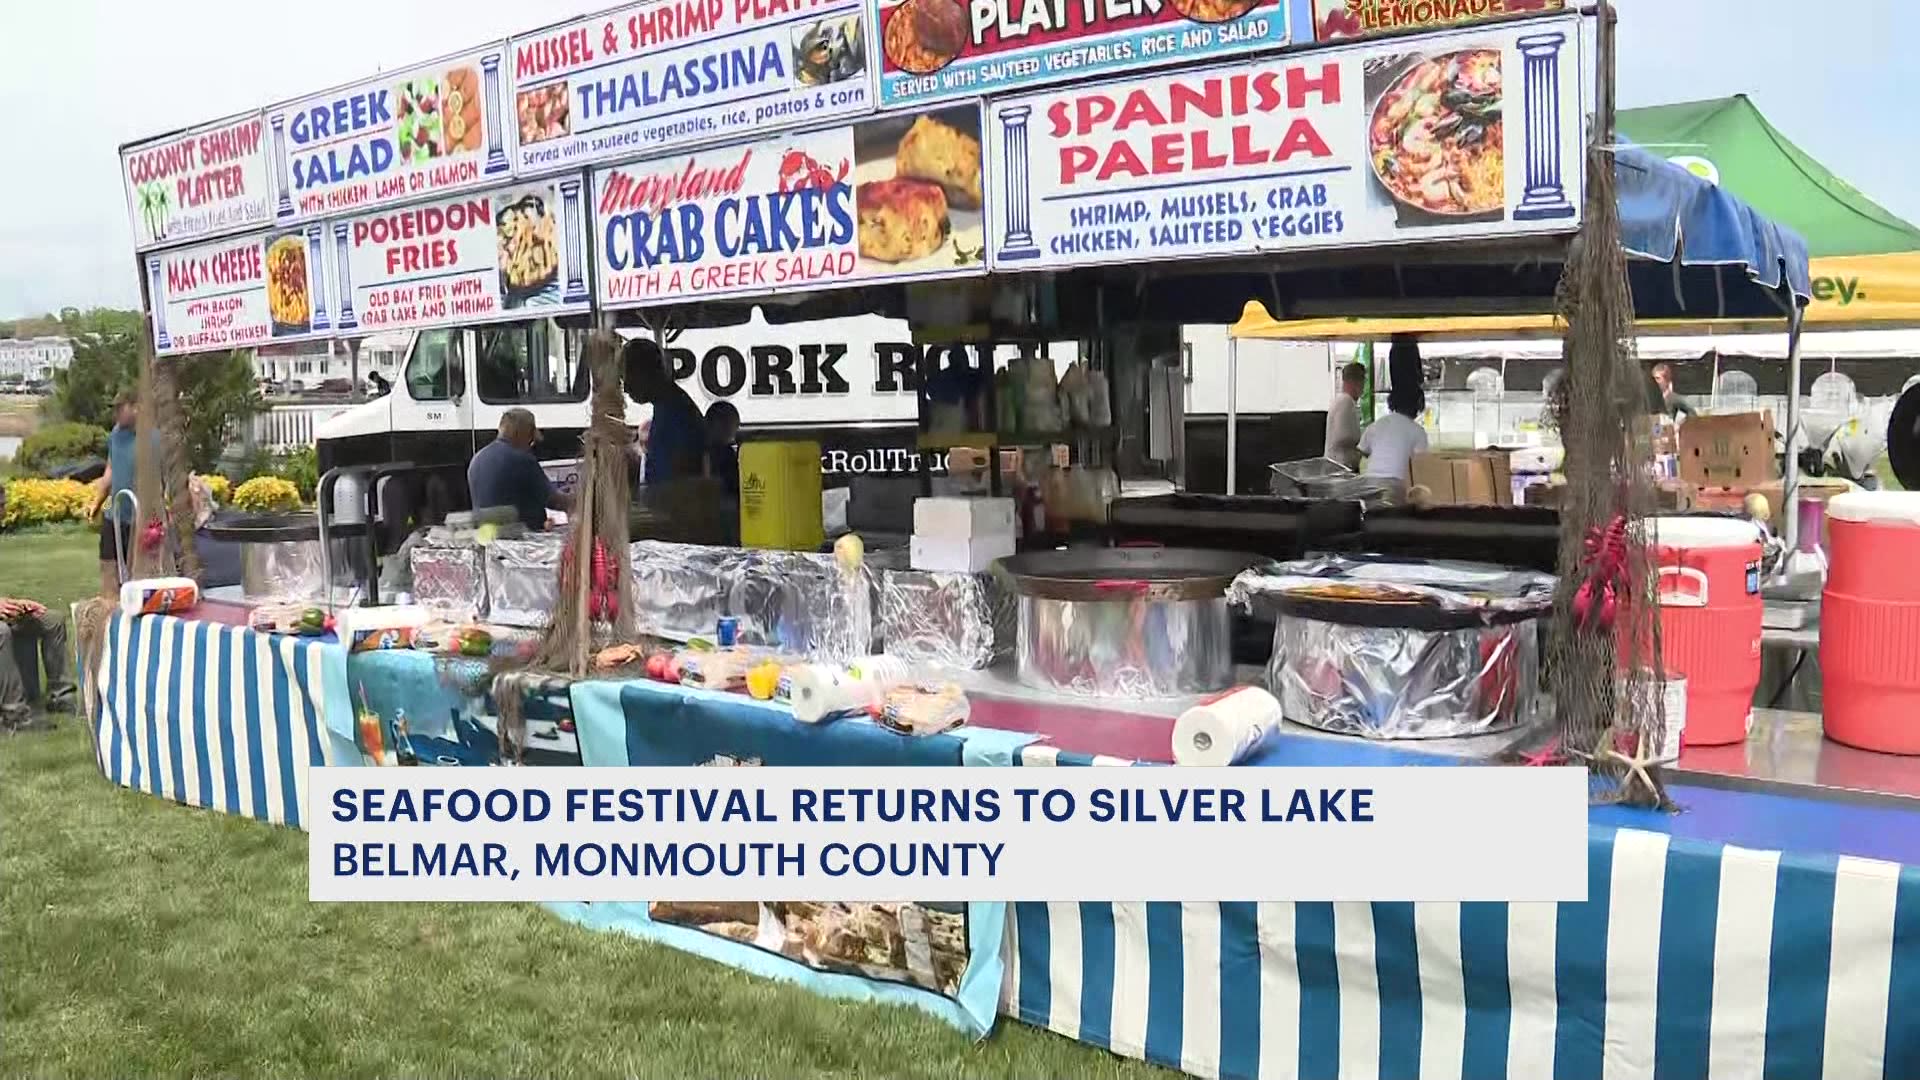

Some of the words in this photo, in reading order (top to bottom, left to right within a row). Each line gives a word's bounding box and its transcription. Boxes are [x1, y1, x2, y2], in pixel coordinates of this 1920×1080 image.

[516, 27, 594, 79] MUSSEL
[603, 22, 618, 55] &
[628, 0, 723, 50] SHRIMP
[1363, 0, 1502, 28] LEMONADE
[576, 41, 785, 119] THALASSINA
[892, 78, 939, 97] SERVED
[943, 71, 976, 88] WITH
[980, 59, 1040, 81] SAUTEED
[1141, 36, 1176, 56] RICE
[1181, 29, 1212, 49] AND
[1218, 19, 1269, 43] SALAD
[290, 89, 391, 144] GREEK
[1047, 63, 1341, 138] SPANISH
[523, 146, 560, 165] Served
[564, 139, 588, 159] with
[591, 130, 640, 152] sauteed
[722, 109, 751, 127] rice,
[814, 92, 825, 108] &
[830, 88, 865, 106] corn
[1059, 119, 1333, 184] PAELLA
[129, 139, 196, 187] COCONUT
[200, 120, 261, 166] SHRIMP
[292, 138, 393, 190] SALAD
[177, 164, 245, 209] PLATTER
[300, 195, 325, 214] WITH
[375, 176, 405, 199] LAMB
[410, 171, 425, 191] OR
[429, 160, 478, 186] SALMON
[599, 148, 753, 215] Maryland
[1070, 200, 1150, 228] SHRIMP,
[1161, 191, 1256, 219] MUSSELS,
[1266, 184, 1327, 209] CRAB
[353, 198, 491, 247] POSEIDON
[605, 203, 705, 271] CRAB
[714, 181, 854, 258] CAKES
[1050, 228, 1140, 255] CHICKEN,
[1151, 219, 1243, 246] SAUTEED
[1252, 210, 1344, 238] VEGGIES
[168, 258, 197, 295] MAC
[212, 244, 262, 284] CHEESE
[386, 239, 459, 274] FRIES
[607, 269, 661, 298] WITH
[668, 271, 682, 293] A
[691, 260, 767, 290] GREEK
[775, 251, 856, 282] SALAD
[187, 301, 209, 317] WITH
[361, 311, 387, 326] CRAB
[392, 306, 417, 321] CAKE
[422, 302, 446, 319] AND
[451, 296, 494, 316] SHRIMP
[369, 291, 390, 307] OLD
[393, 288, 414, 302] BAY
[418, 285, 446, 300] FRIES
[451, 279, 482, 296] WITH
[174, 335, 186, 348] OR
[188, 330, 227, 346] BUFFALO
[231, 325, 268, 342] CHICKEN
